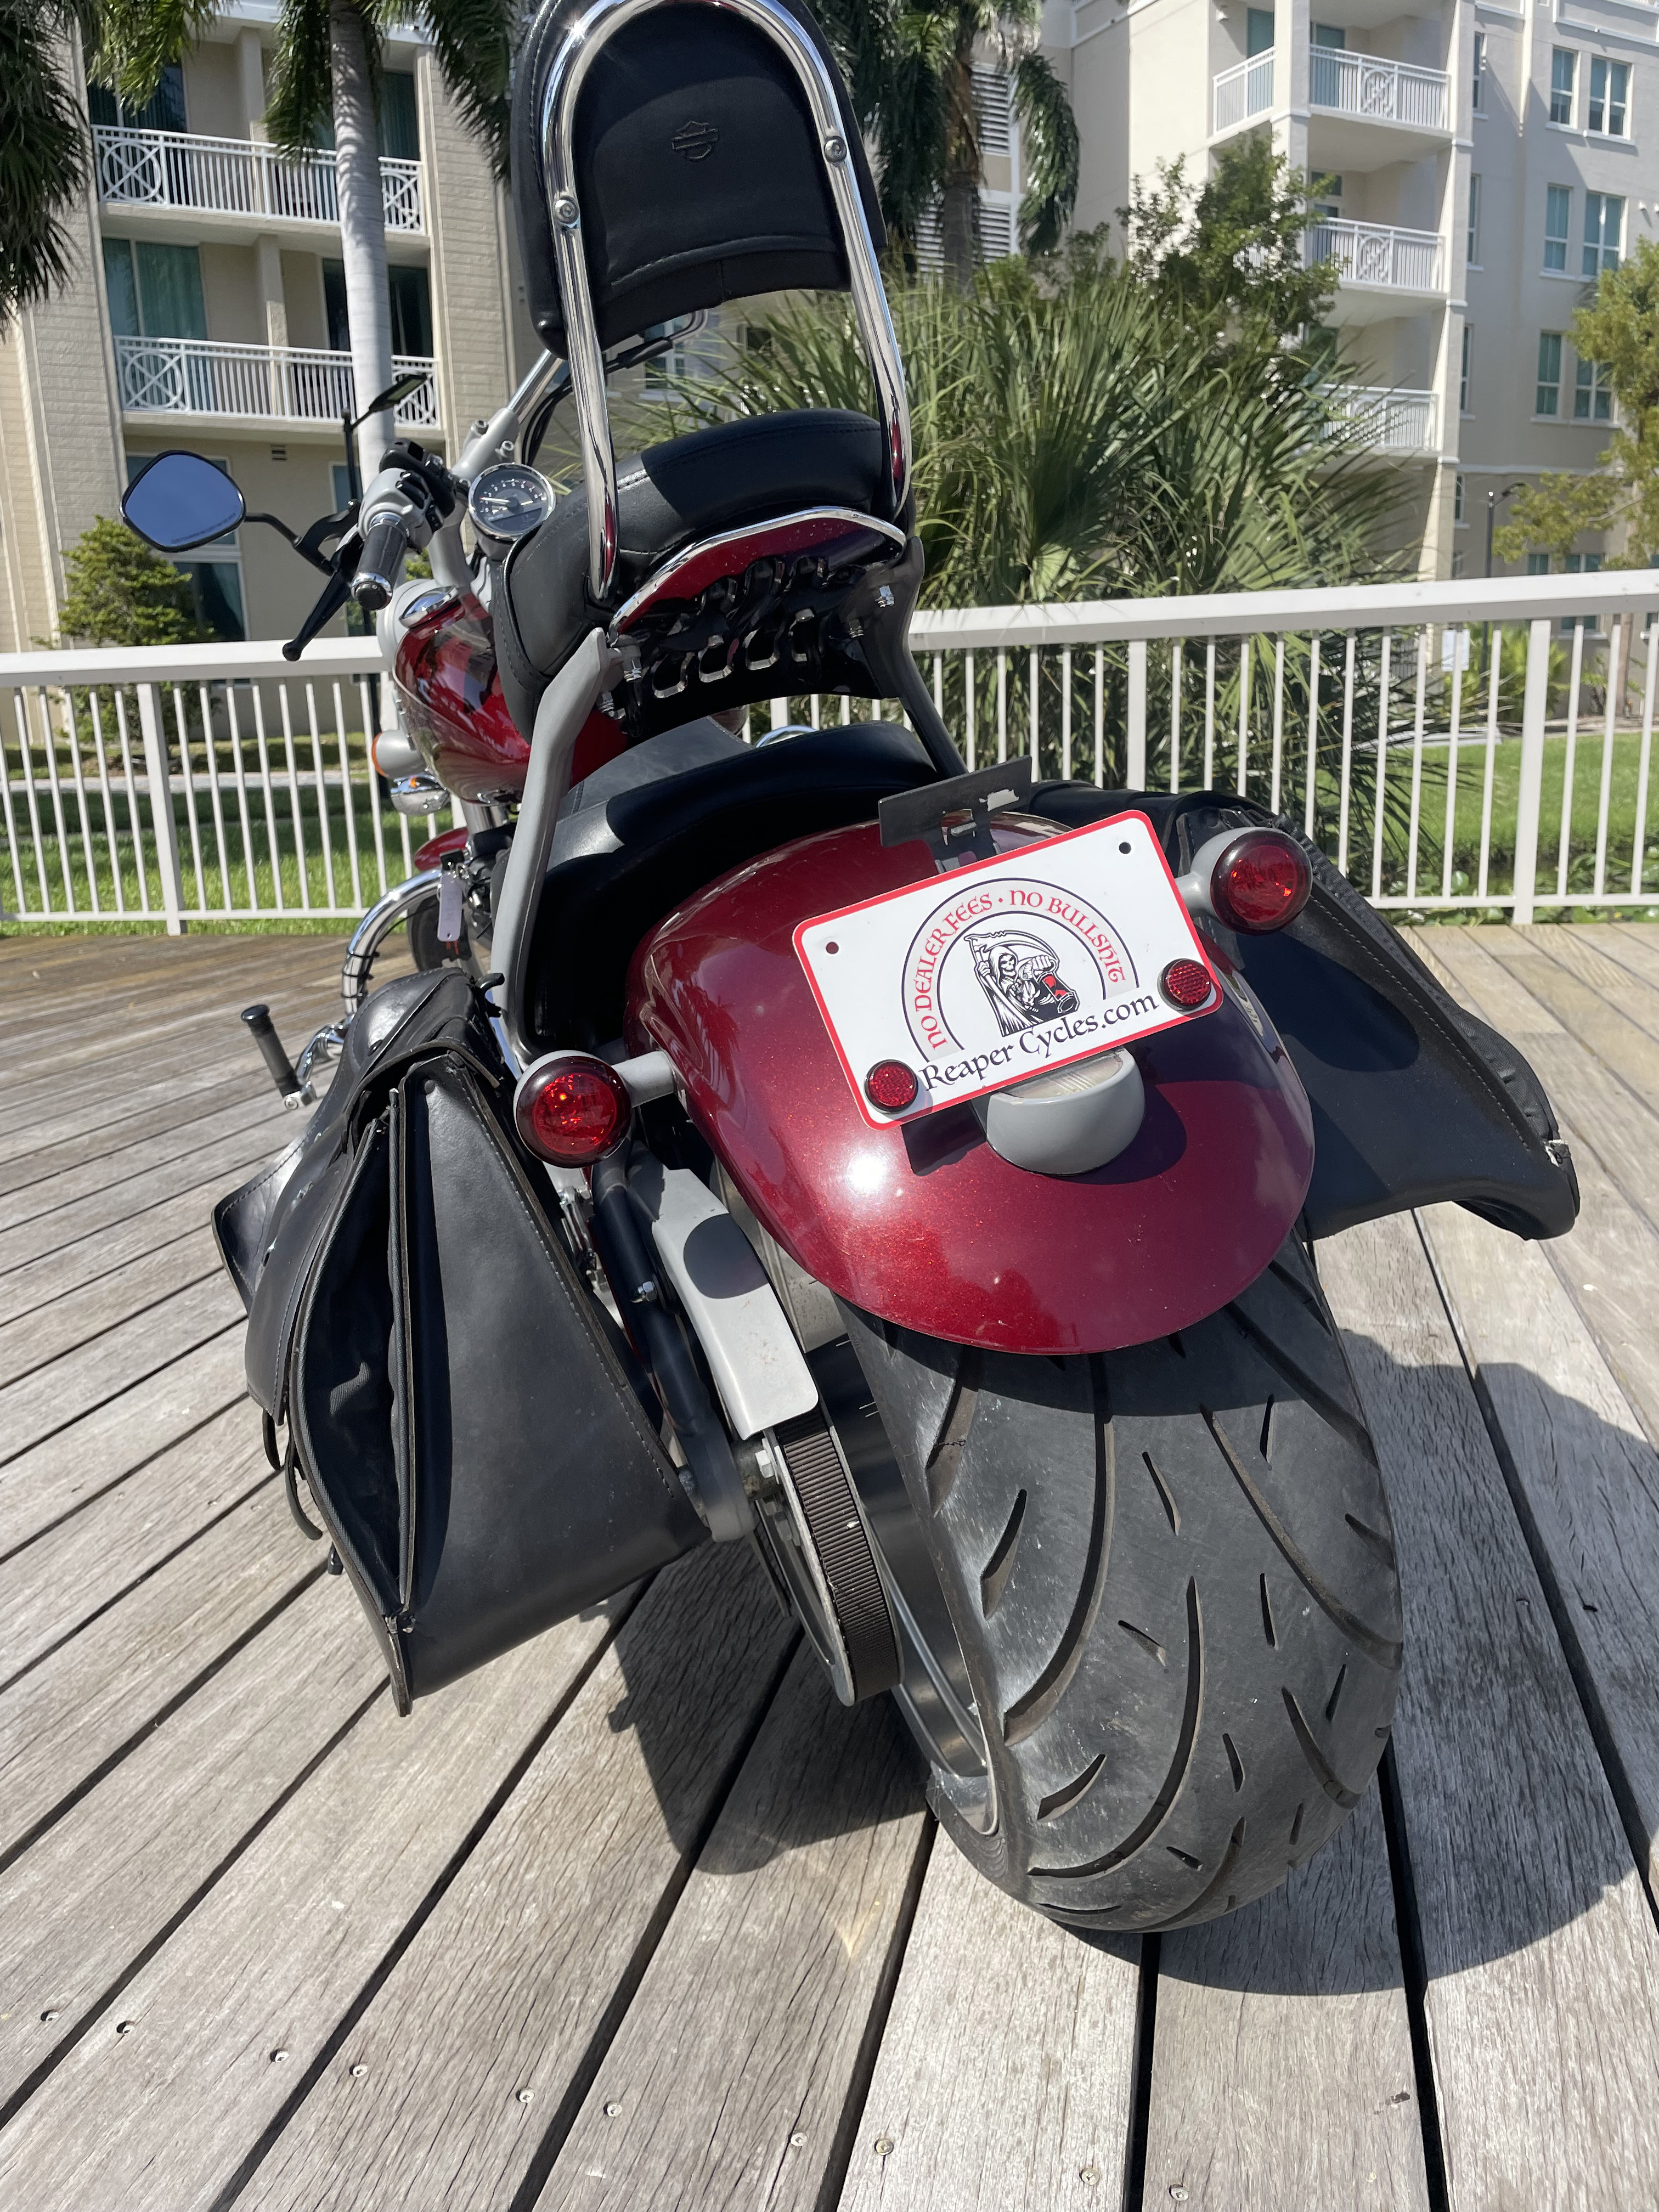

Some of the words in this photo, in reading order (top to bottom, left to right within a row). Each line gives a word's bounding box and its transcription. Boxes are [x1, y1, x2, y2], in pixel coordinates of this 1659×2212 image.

[914, 928, 956, 1012] DEALER
[943, 893, 992, 933] FEES
[1045, 896, 1126, 983] BULLSHIT
[918, 1043, 1014, 1091] Reaper
[1019, 995, 1159, 1058] Cycles.com
